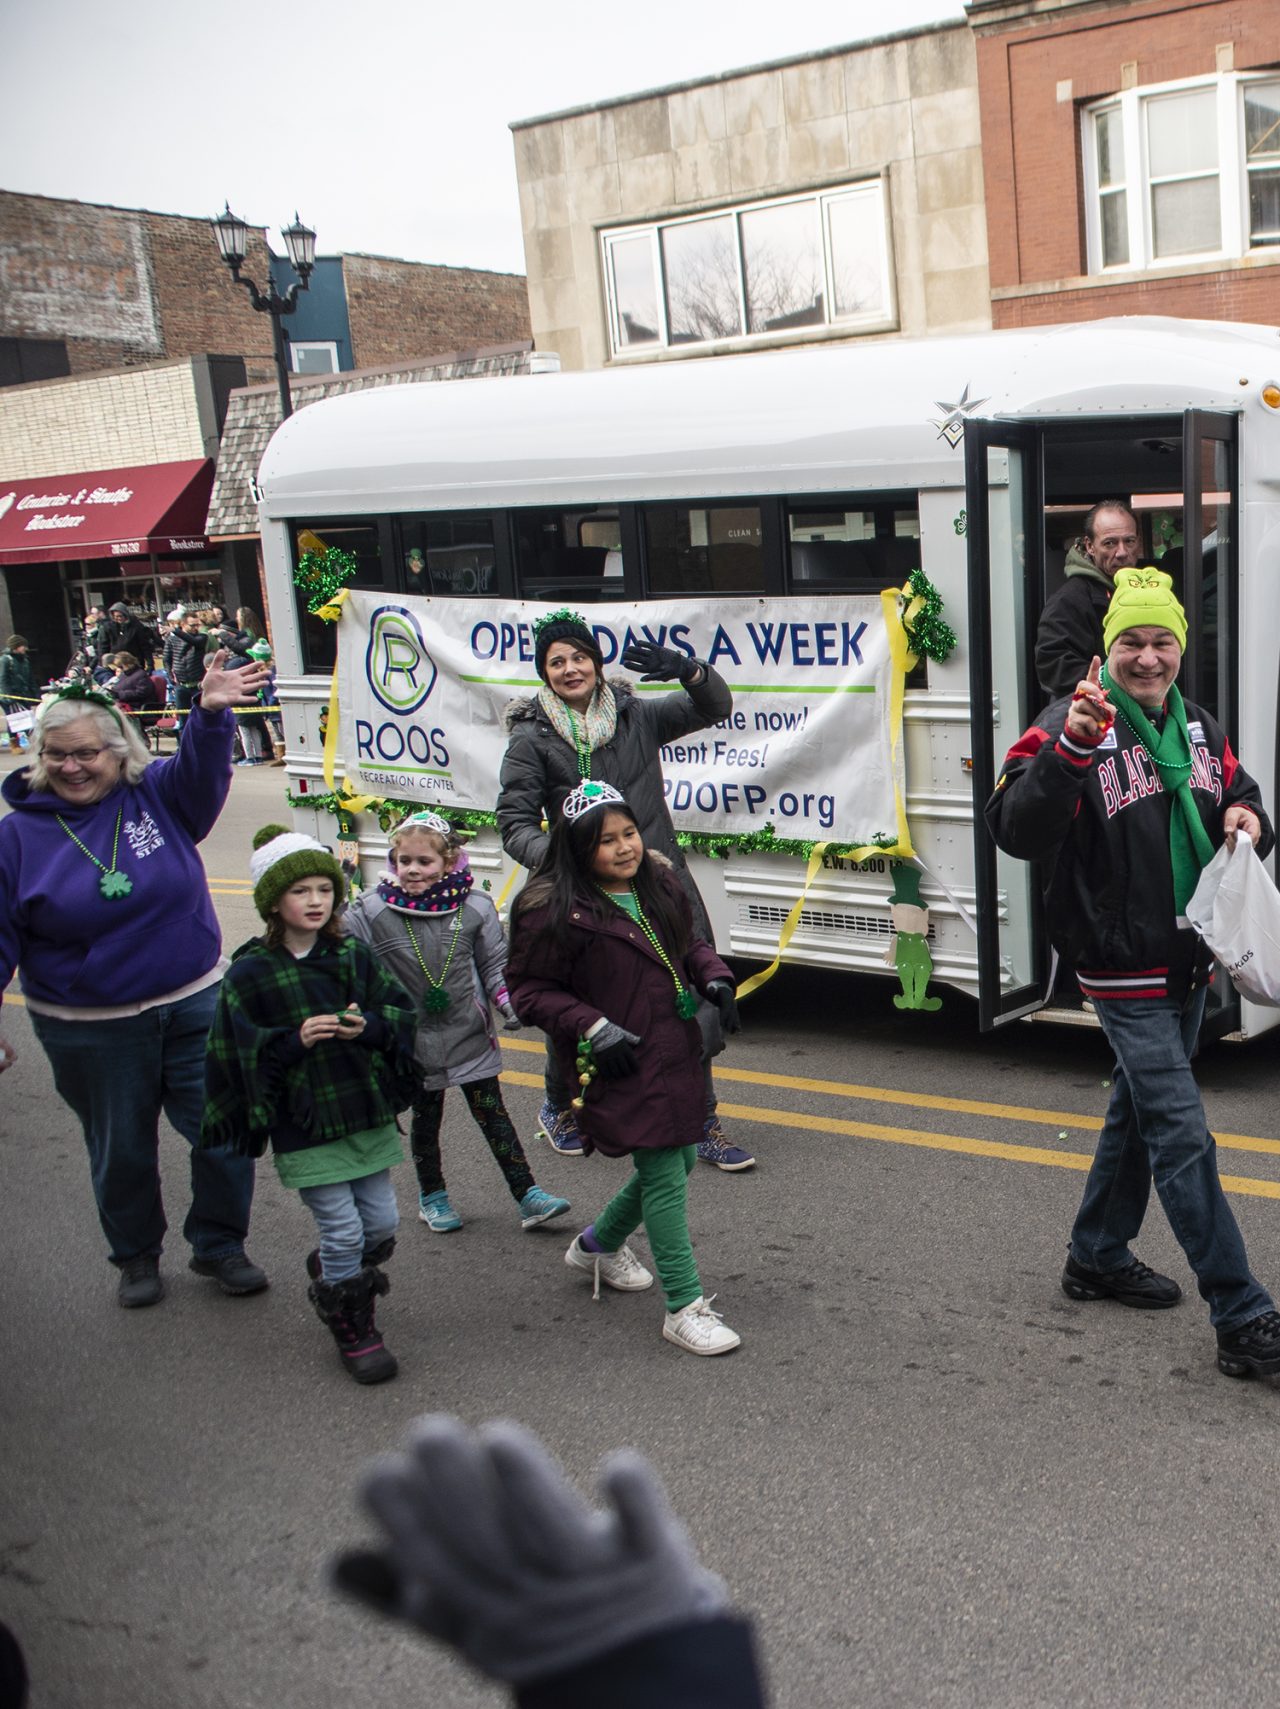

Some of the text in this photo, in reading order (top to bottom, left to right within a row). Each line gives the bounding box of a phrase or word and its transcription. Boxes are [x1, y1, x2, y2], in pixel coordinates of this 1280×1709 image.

[24, 513, 86, 531] Bookstore
[169, 538, 205, 550] Bookstore
[470, 620, 536, 663] OPE
[708, 622, 742, 667] A
[746, 620, 869, 668] WEEK
[754, 706, 809, 732] now!
[355, 719, 450, 768] ROOS
[712, 742, 769, 769] Fees!
[359, 770, 455, 792] RECREATION CENTER
[664, 778, 836, 829] DOFP.org
